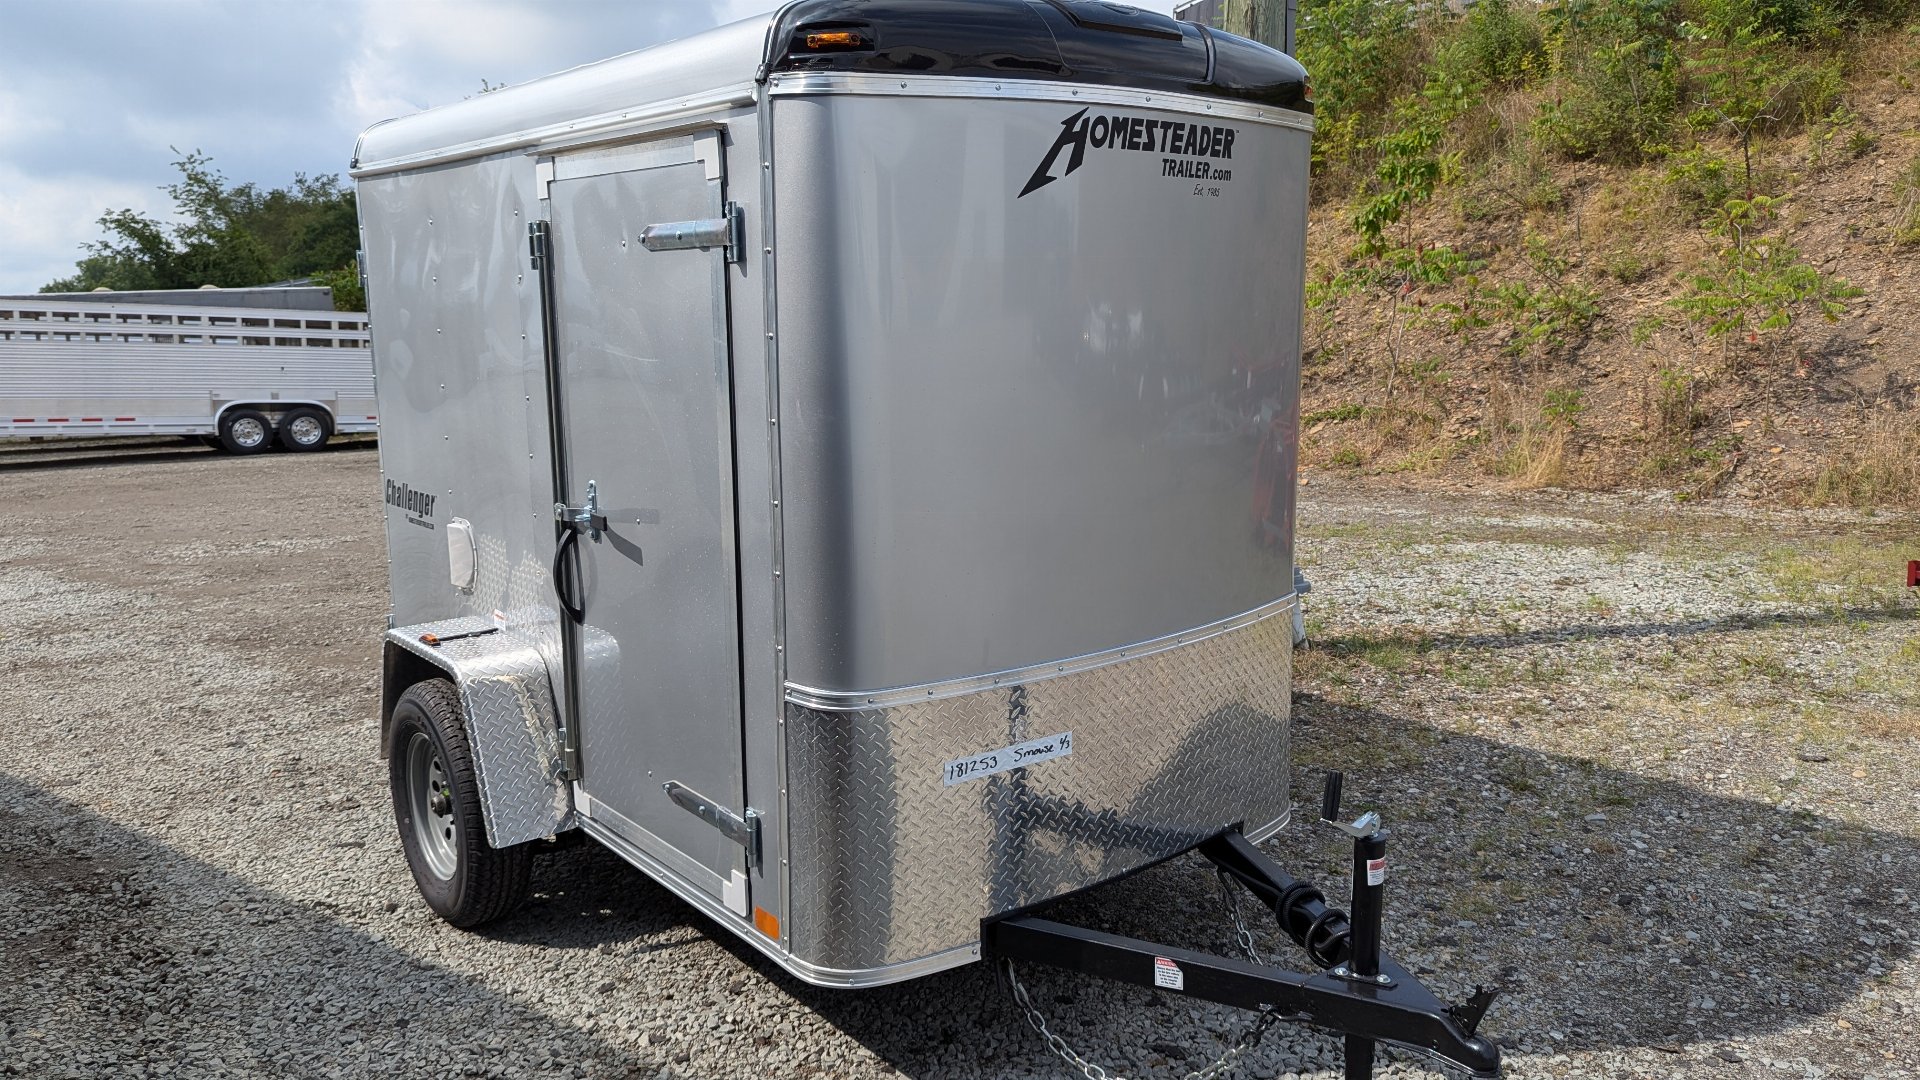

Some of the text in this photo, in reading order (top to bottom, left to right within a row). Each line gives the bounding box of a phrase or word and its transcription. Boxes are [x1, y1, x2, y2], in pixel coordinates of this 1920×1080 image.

[1017, 106, 1235, 199] HOMESTEADER
[1162, 158, 1232, 181] TRAILER.com
[386, 478, 436, 518] Challenger
[949, 756, 998, 780] 181253
